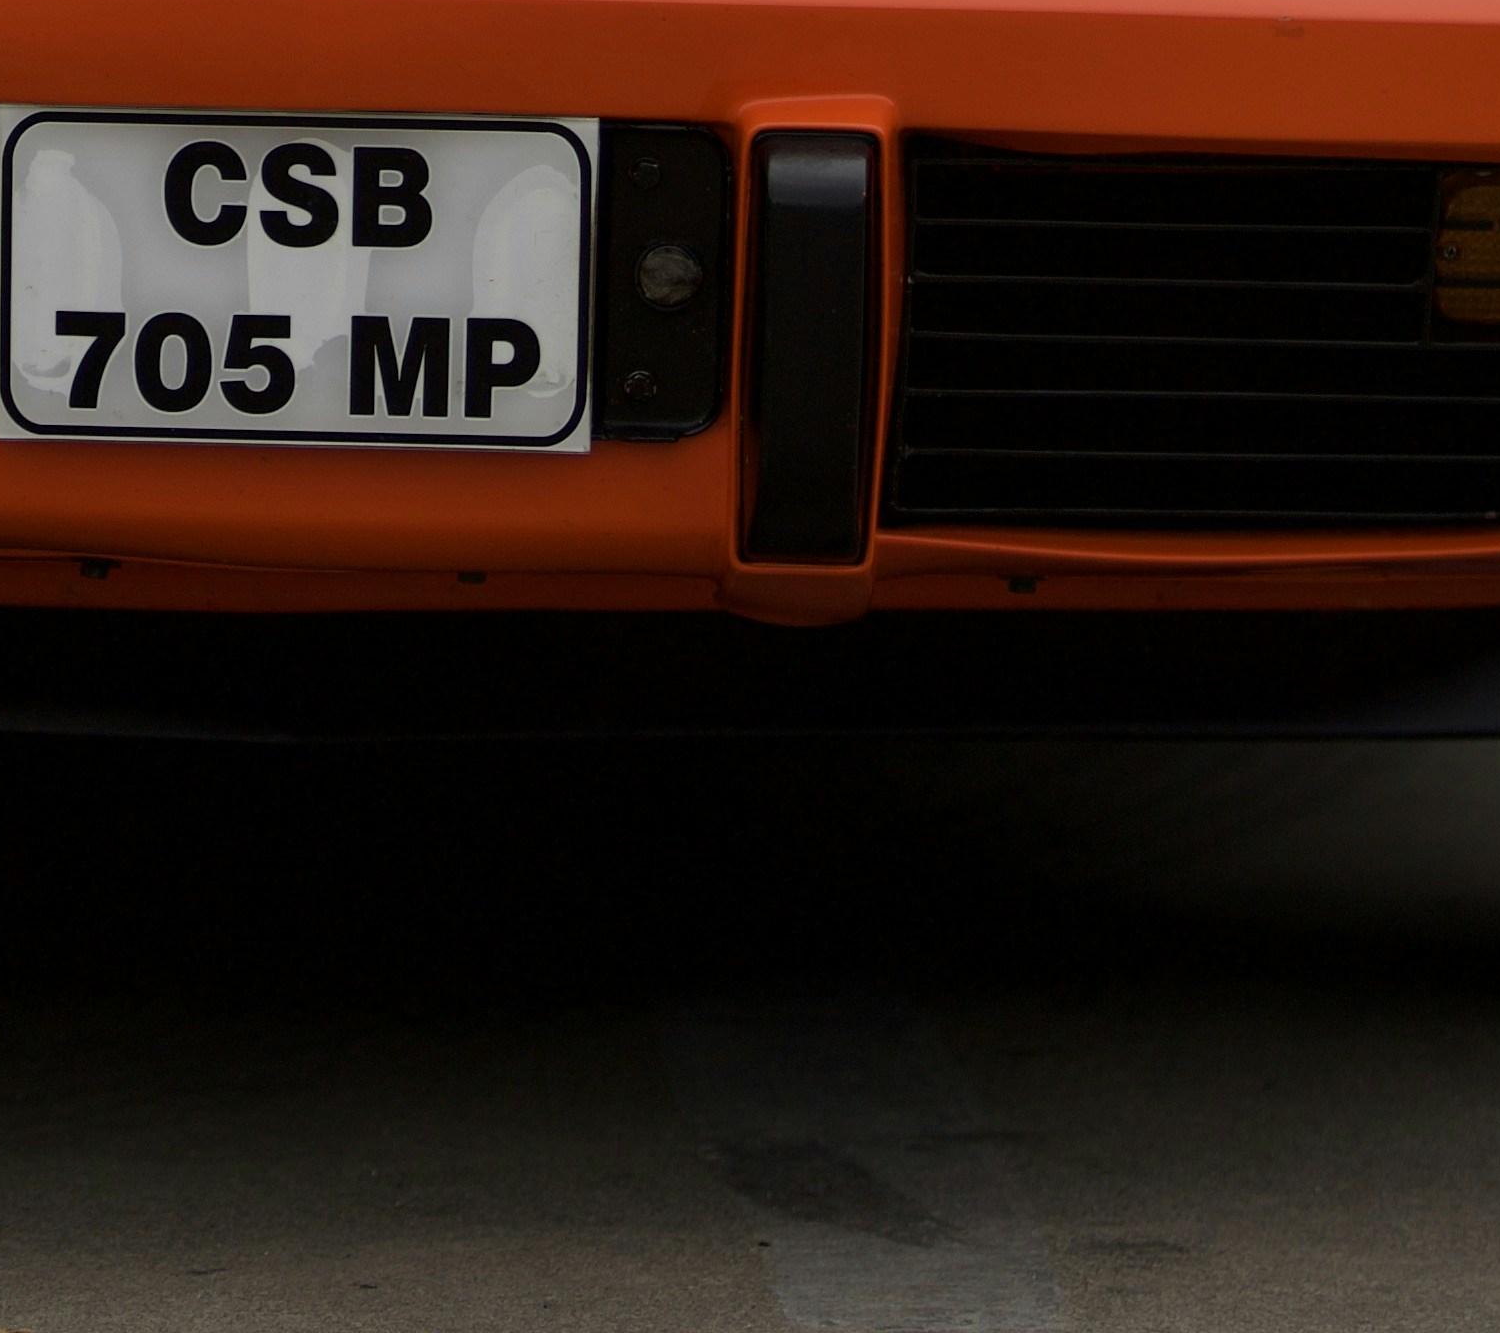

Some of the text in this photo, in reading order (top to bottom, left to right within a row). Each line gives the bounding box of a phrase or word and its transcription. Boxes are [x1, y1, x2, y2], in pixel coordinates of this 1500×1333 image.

[164, 140, 433, 248] CSB
[55, 310, 541, 419] 705 MP
